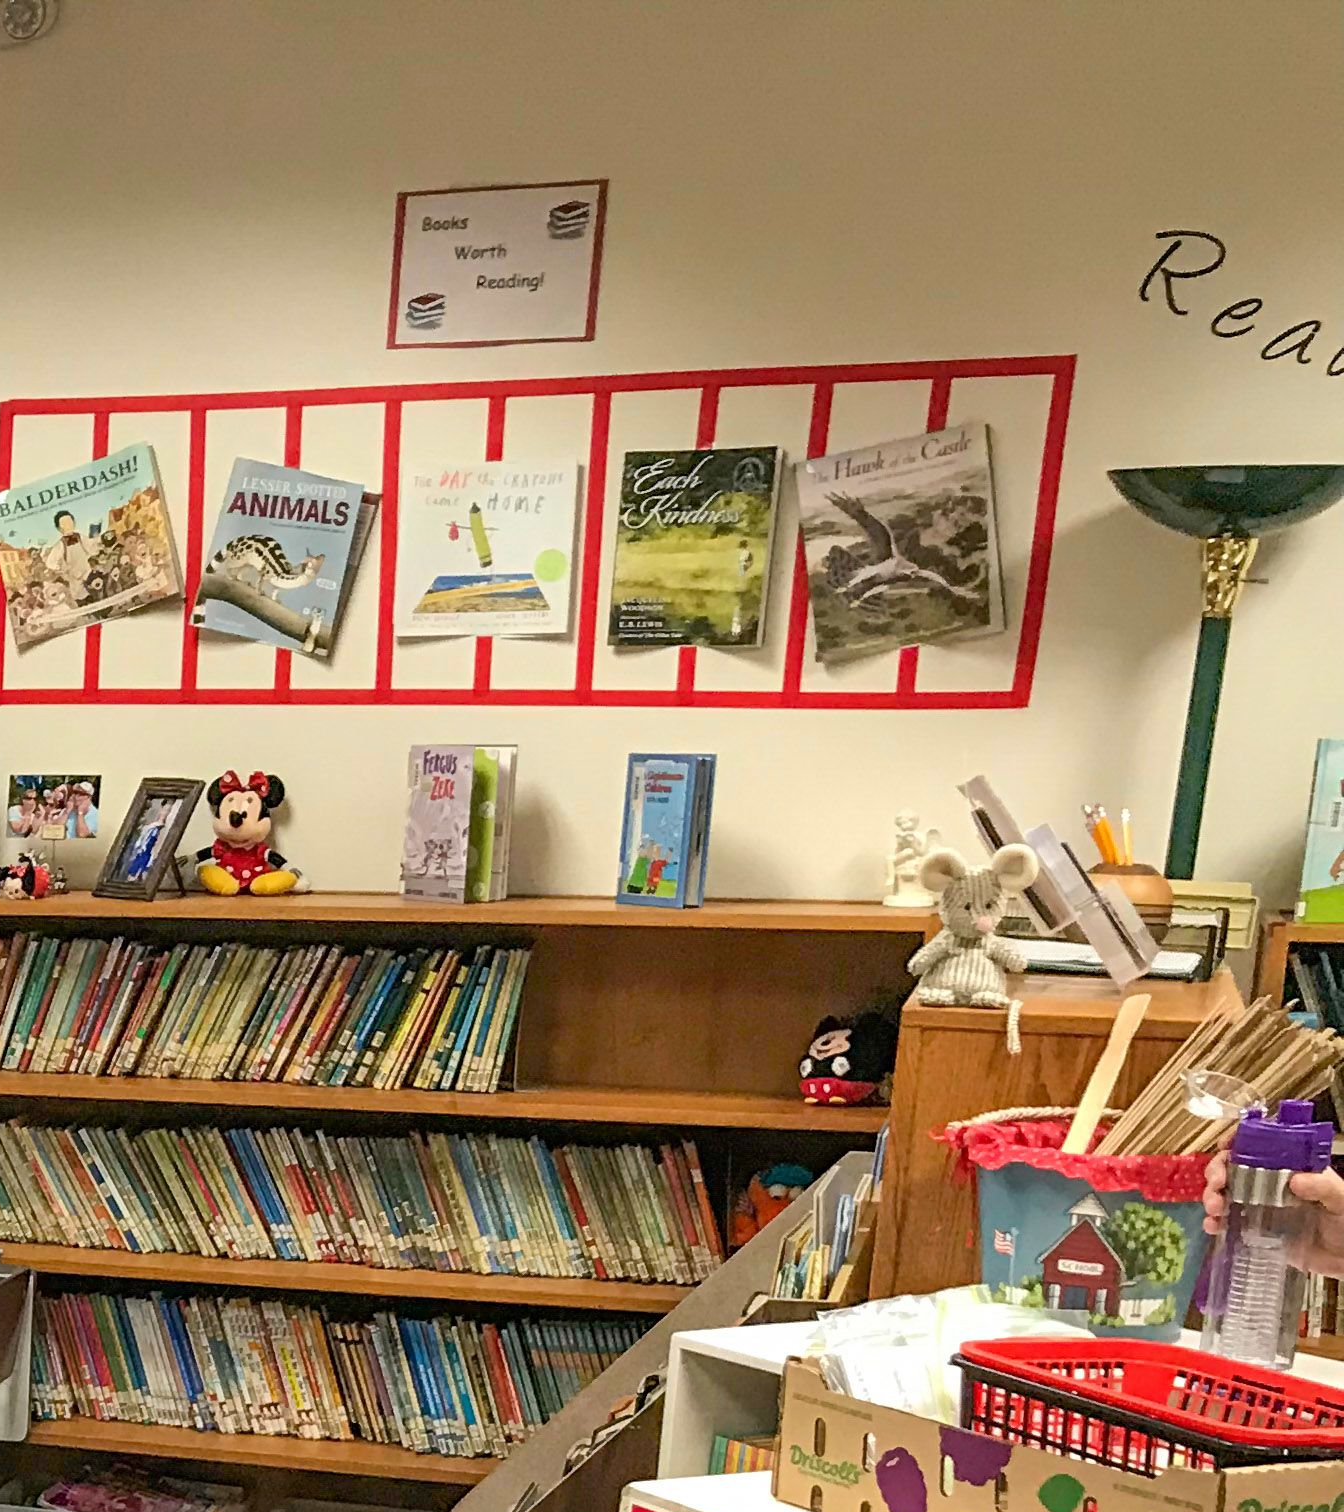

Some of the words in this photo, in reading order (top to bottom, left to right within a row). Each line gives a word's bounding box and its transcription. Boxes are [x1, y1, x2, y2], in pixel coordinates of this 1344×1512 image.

[421, 216, 470, 231] Books
[453, 243, 508, 260] Worth
[475, 271, 546, 292] Reading!
[834, 449, 887, 480] Hawk
[920, 430, 973, 460] Castle
[241, 476, 291, 494] LESSER
[295, 480, 348, 498] SPOTTED
[439, 469, 473, 490] DAY
[633, 454, 715, 496] Each
[226, 491, 352, 527] ANIMALS
[486, 492, 546, 515] HOME
[619, 489, 741, 530] Kindness
[422, 749, 459, 776] FERGUS
[429, 776, 456, 801] ZEKE
